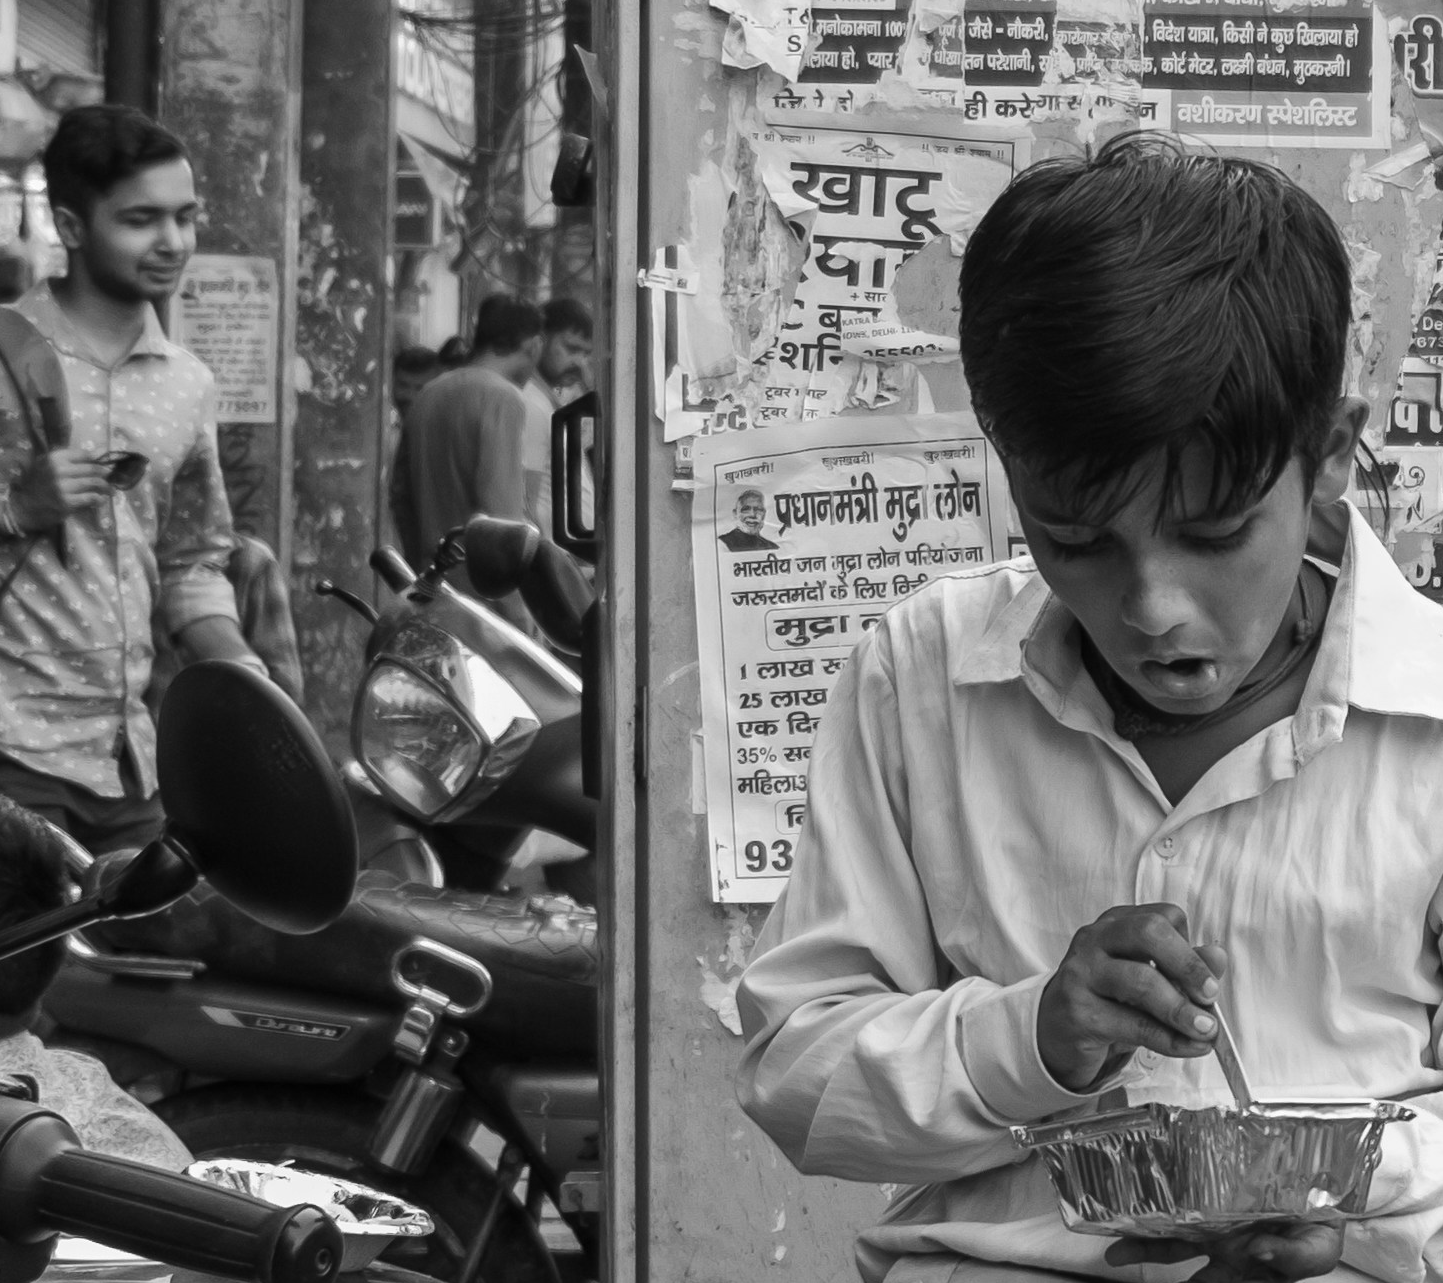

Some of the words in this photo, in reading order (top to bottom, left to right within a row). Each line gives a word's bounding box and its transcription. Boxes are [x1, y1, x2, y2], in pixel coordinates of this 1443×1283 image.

[816, 13, 882, 38] मनोकामना
[1153, 18, 1186, 44] विदेश
[1222, 19, 1255, 45] किसी
[1256, 22, 1269, 45] ने
[1296, 21, 1343, 47] खिलाया
[1344, 23, 1360, 48] हो
[1176, 95, 1264, 125] वशीकरण
[1266, 97, 1358, 128] स्पेशलिस्ट
[789, 161, 945, 244] खाटू
[774, 471, 880, 536] प्रधानमंत्री
[883, 483, 929, 544] मुद्रा
[933, 468, 983, 521] लोन
[732, 551, 792, 579] भारतीय
[796, 554, 827, 575] जन
[831, 553, 863, 581] मुद्रा
[866, 545, 901, 570] लोन
[829, 574, 849, 601] के
[852, 575, 887, 601] लिए
[772, 614, 851, 648] मुद्रा
[756, 657, 815, 680] लाख
[738, 692, 764, 710] 25
[769, 687, 829, 709] लाख
[736, 719, 780, 739] एक
[736, 746, 778, 765] 35%
